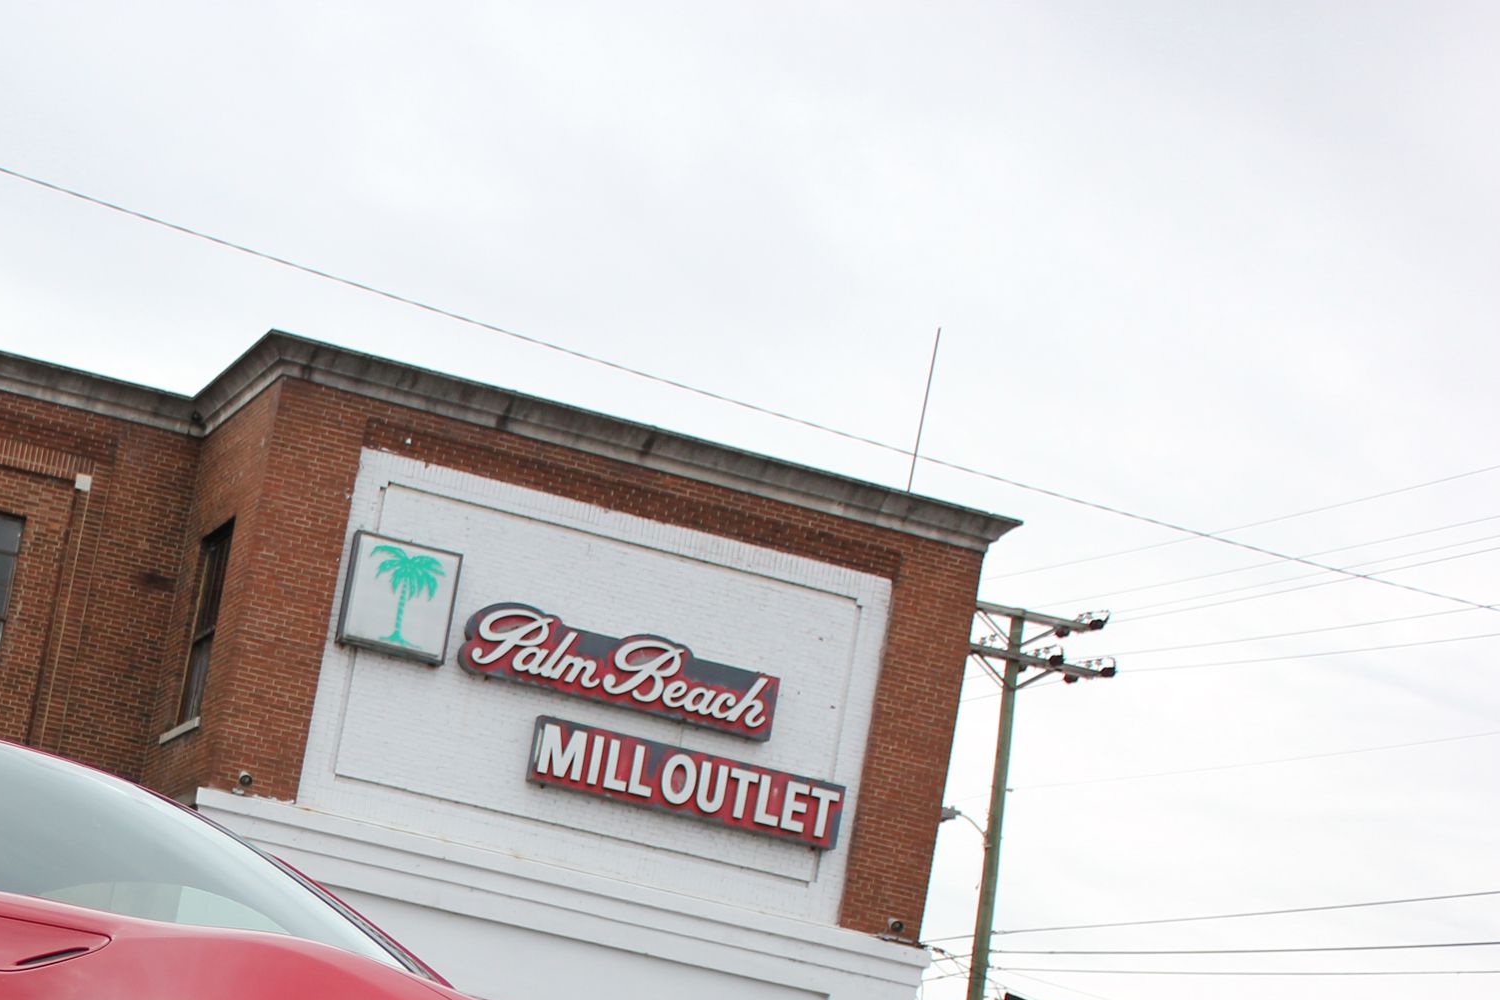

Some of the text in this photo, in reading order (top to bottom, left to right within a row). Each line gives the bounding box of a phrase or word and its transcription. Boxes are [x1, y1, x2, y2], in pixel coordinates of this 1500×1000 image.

[471, 608, 766, 728] Palm Beach
[536, 723, 840, 838] MILL OUTLET
